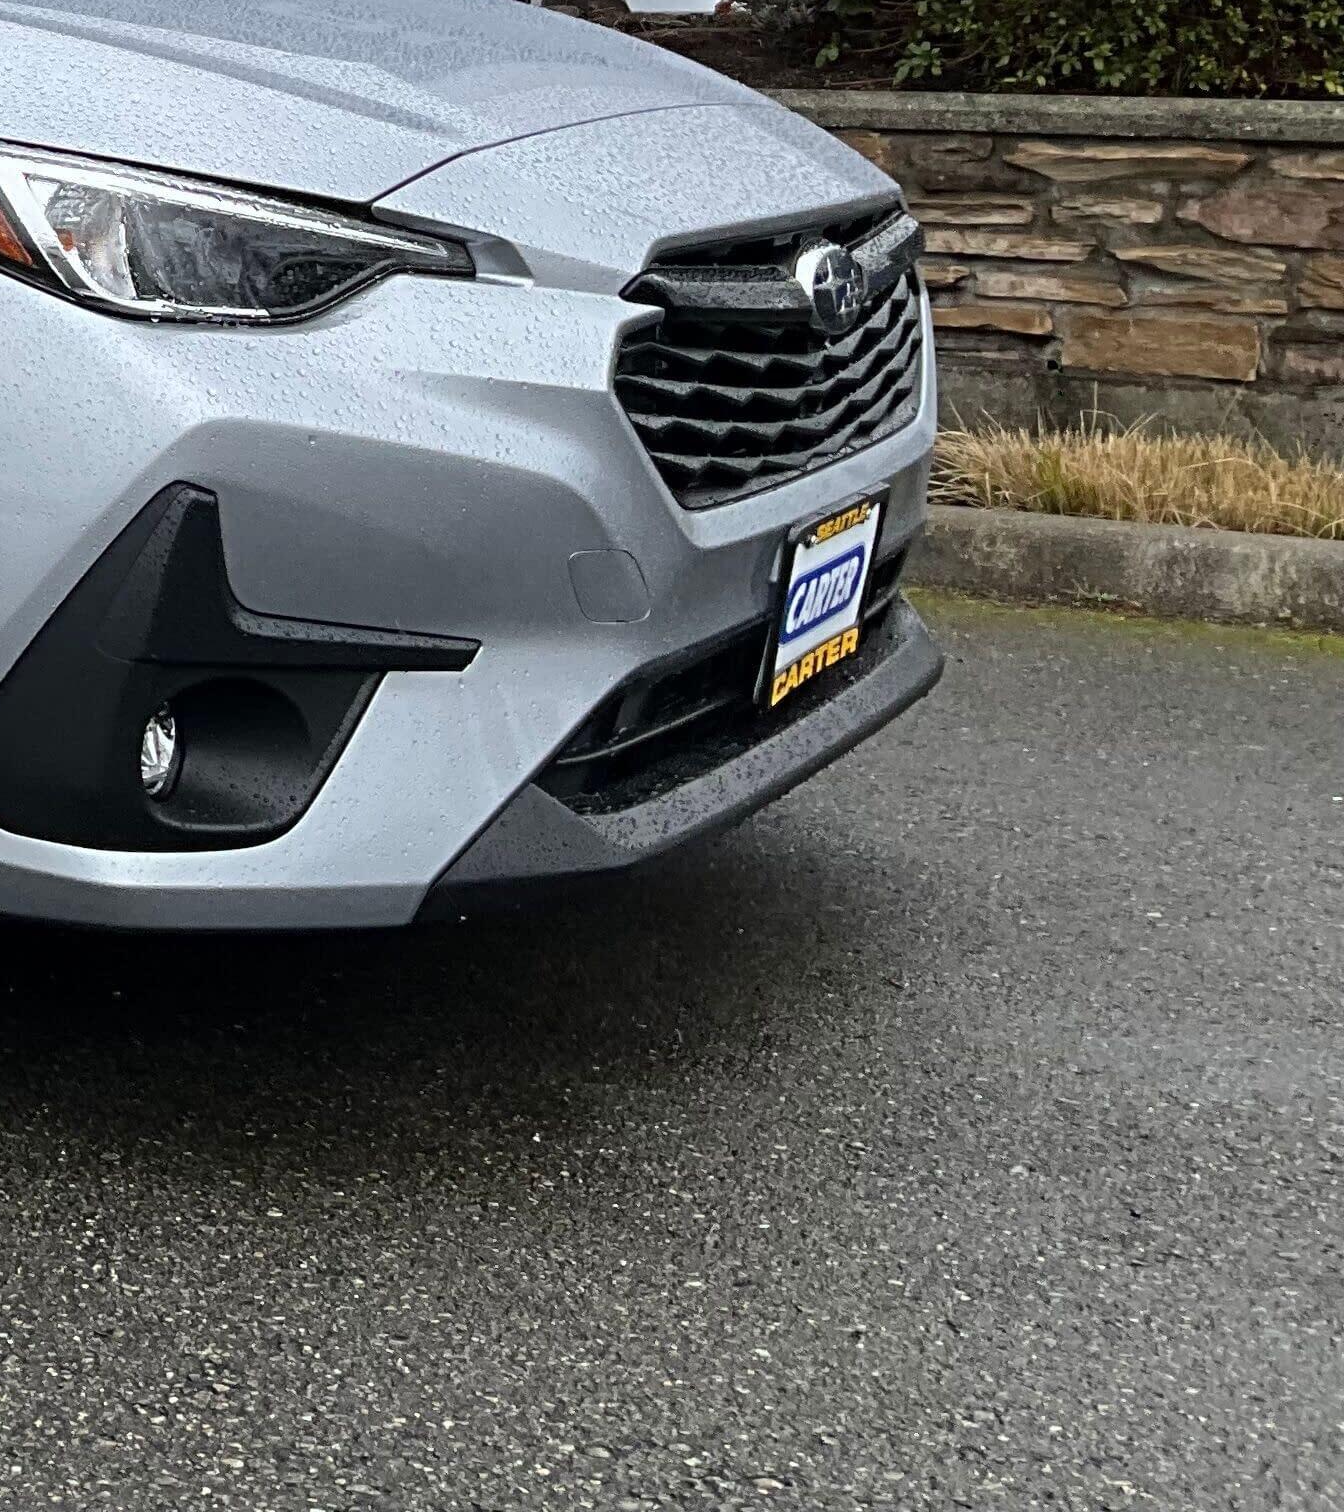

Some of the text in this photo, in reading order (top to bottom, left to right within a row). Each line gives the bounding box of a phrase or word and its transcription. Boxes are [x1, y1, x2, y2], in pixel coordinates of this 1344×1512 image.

[816, 502, 870, 541] SEATTLE
[786, 555, 859, 634] CARTER
[771, 628, 859, 707] CARTER
